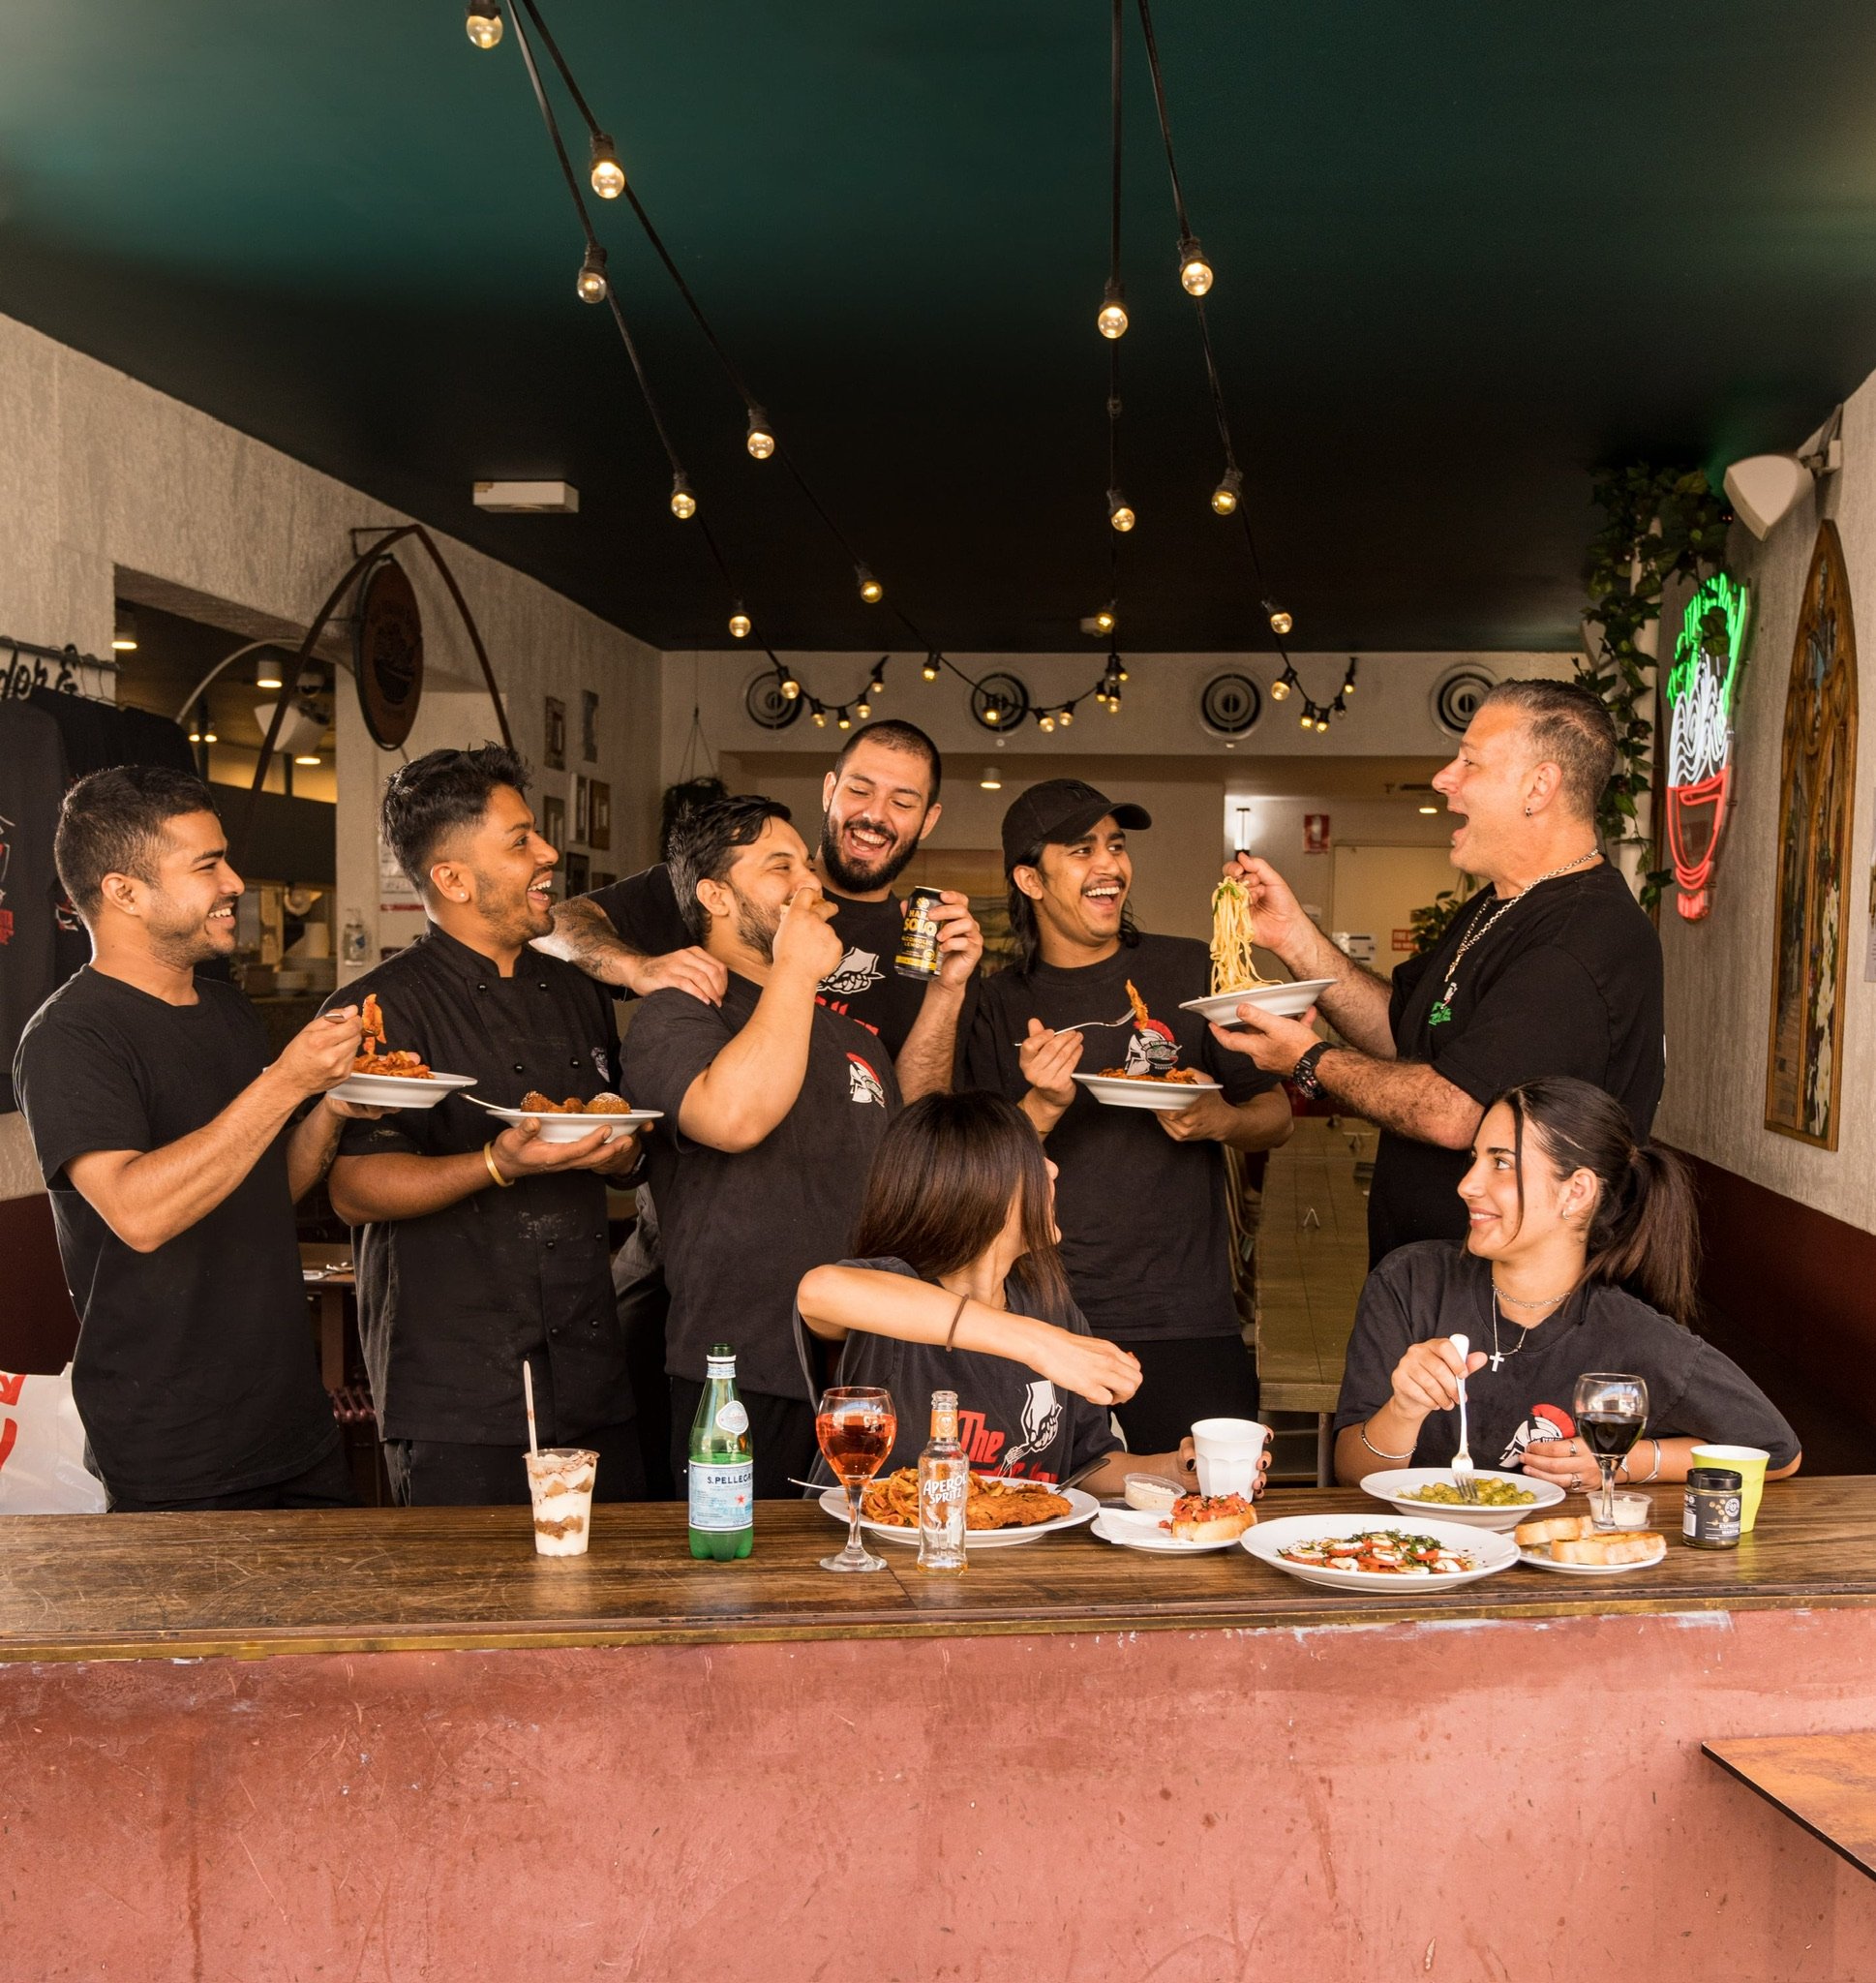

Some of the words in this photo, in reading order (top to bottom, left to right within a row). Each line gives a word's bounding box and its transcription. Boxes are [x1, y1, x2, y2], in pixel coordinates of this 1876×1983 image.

[903, 918, 937, 937] SOLO
[957, 1410, 1006, 1463] The
[923, 1472, 967, 1496] APEROL
[929, 1487, 962, 1505] SPRITZ
